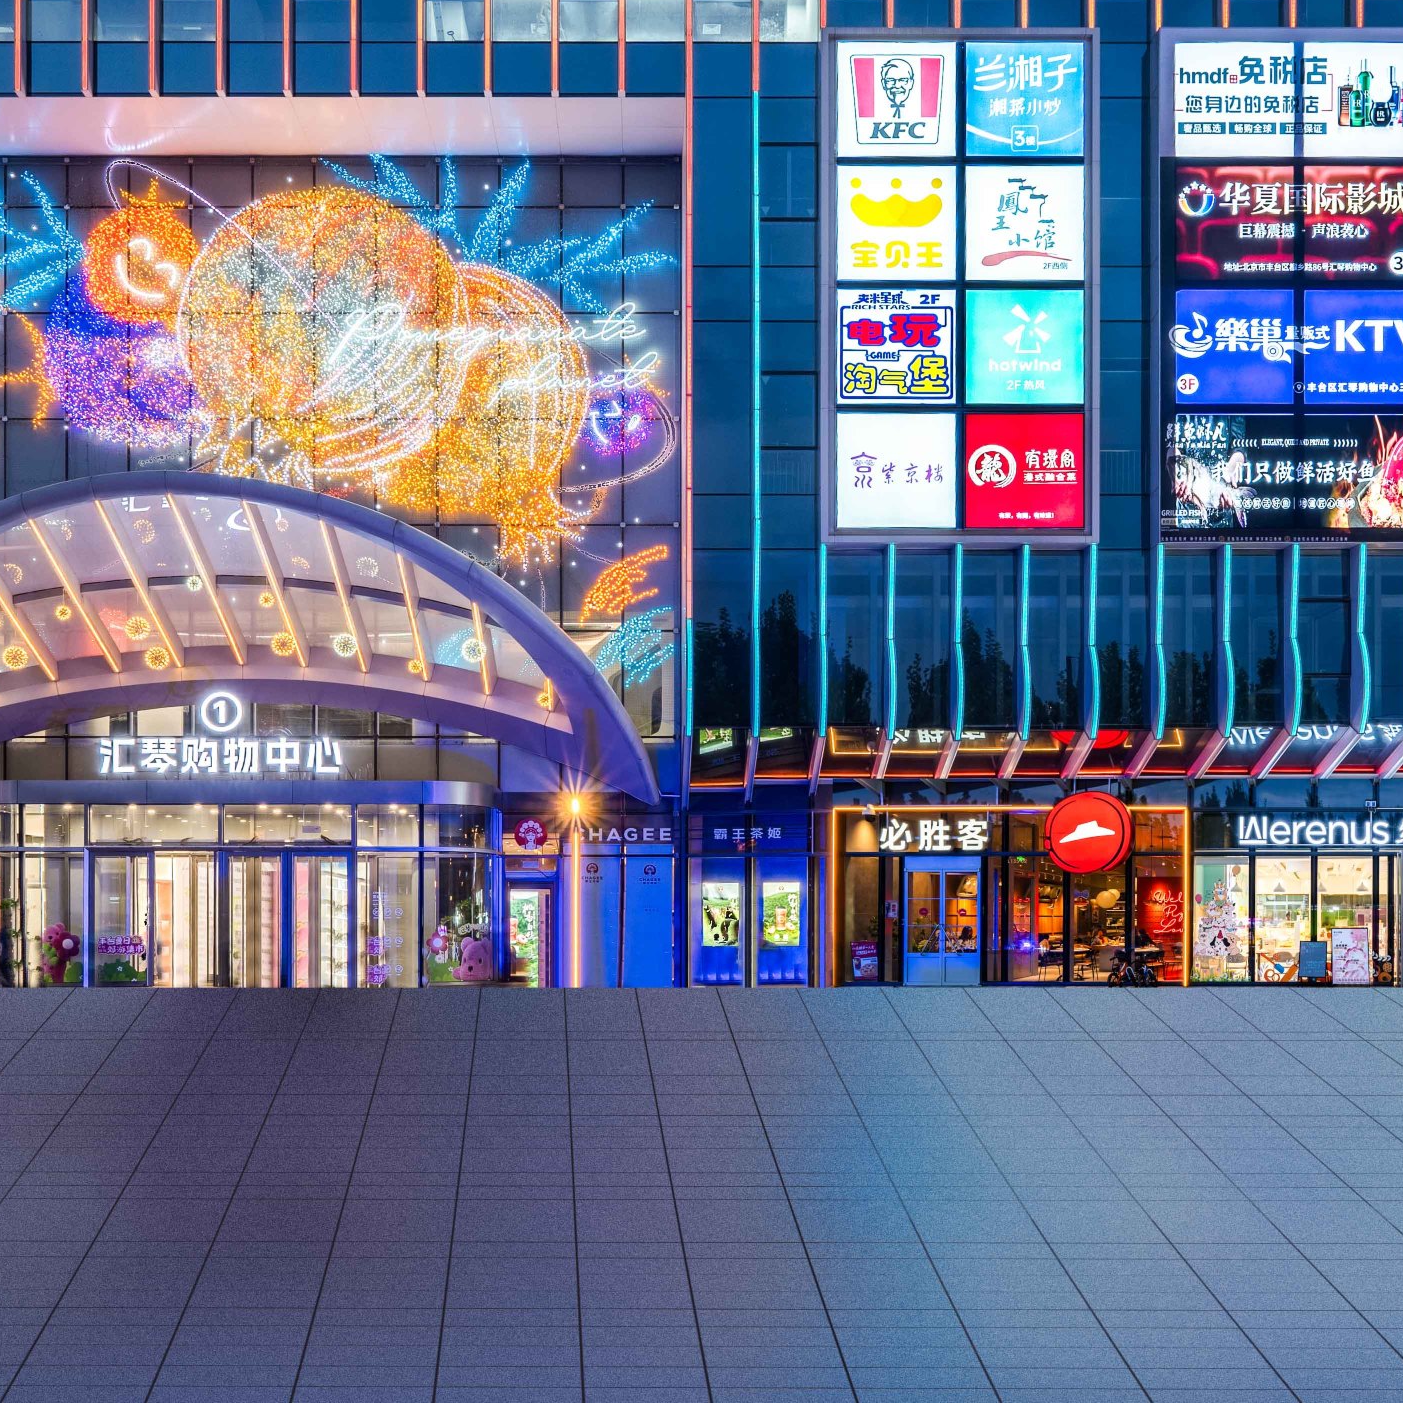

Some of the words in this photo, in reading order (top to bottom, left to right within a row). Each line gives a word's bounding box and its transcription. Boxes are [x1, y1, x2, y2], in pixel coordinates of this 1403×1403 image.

[973, 53, 1078, 93] 兰湘子
[1179, 67, 1229, 85] hmdf
[1238, 55, 1328, 86] 免税店
[989, 97, 1062, 117] 湘菜小炒
[1185, 94, 1320, 114] 您身边的免税店
[870, 121, 926, 139] KFC
[1285, 123, 1323, 134] 正品保证
[1238, 222, 1296, 239] 巨幕震撼
[1311, 222, 1370, 239] 声浪袭心
[850, 240, 943, 269] 宝贝王
[919, 294, 941, 304] 2F
[847, 313, 942, 347] 电玩
[870, 351, 897, 360] GAME
[988, 358, 1062, 372] hotwind
[844, 354, 950, 394] 淘气堡
[1180, 378, 1195, 389] 3F
[1006, 380, 1021, 390] 2F
[881, 462, 943, 484] 紫京楼
[1212, 460, 1374, 485] 我们只做鲜活好鱼
[1161, 509, 1188, 517] GRILLED
[99, 737, 343, 774] 汇琴购物中心
[713, 827, 783, 840] 霸王茶姬
[879, 818, 989, 852] 必胜客
[1239, 815, 1391, 845] Werenus
